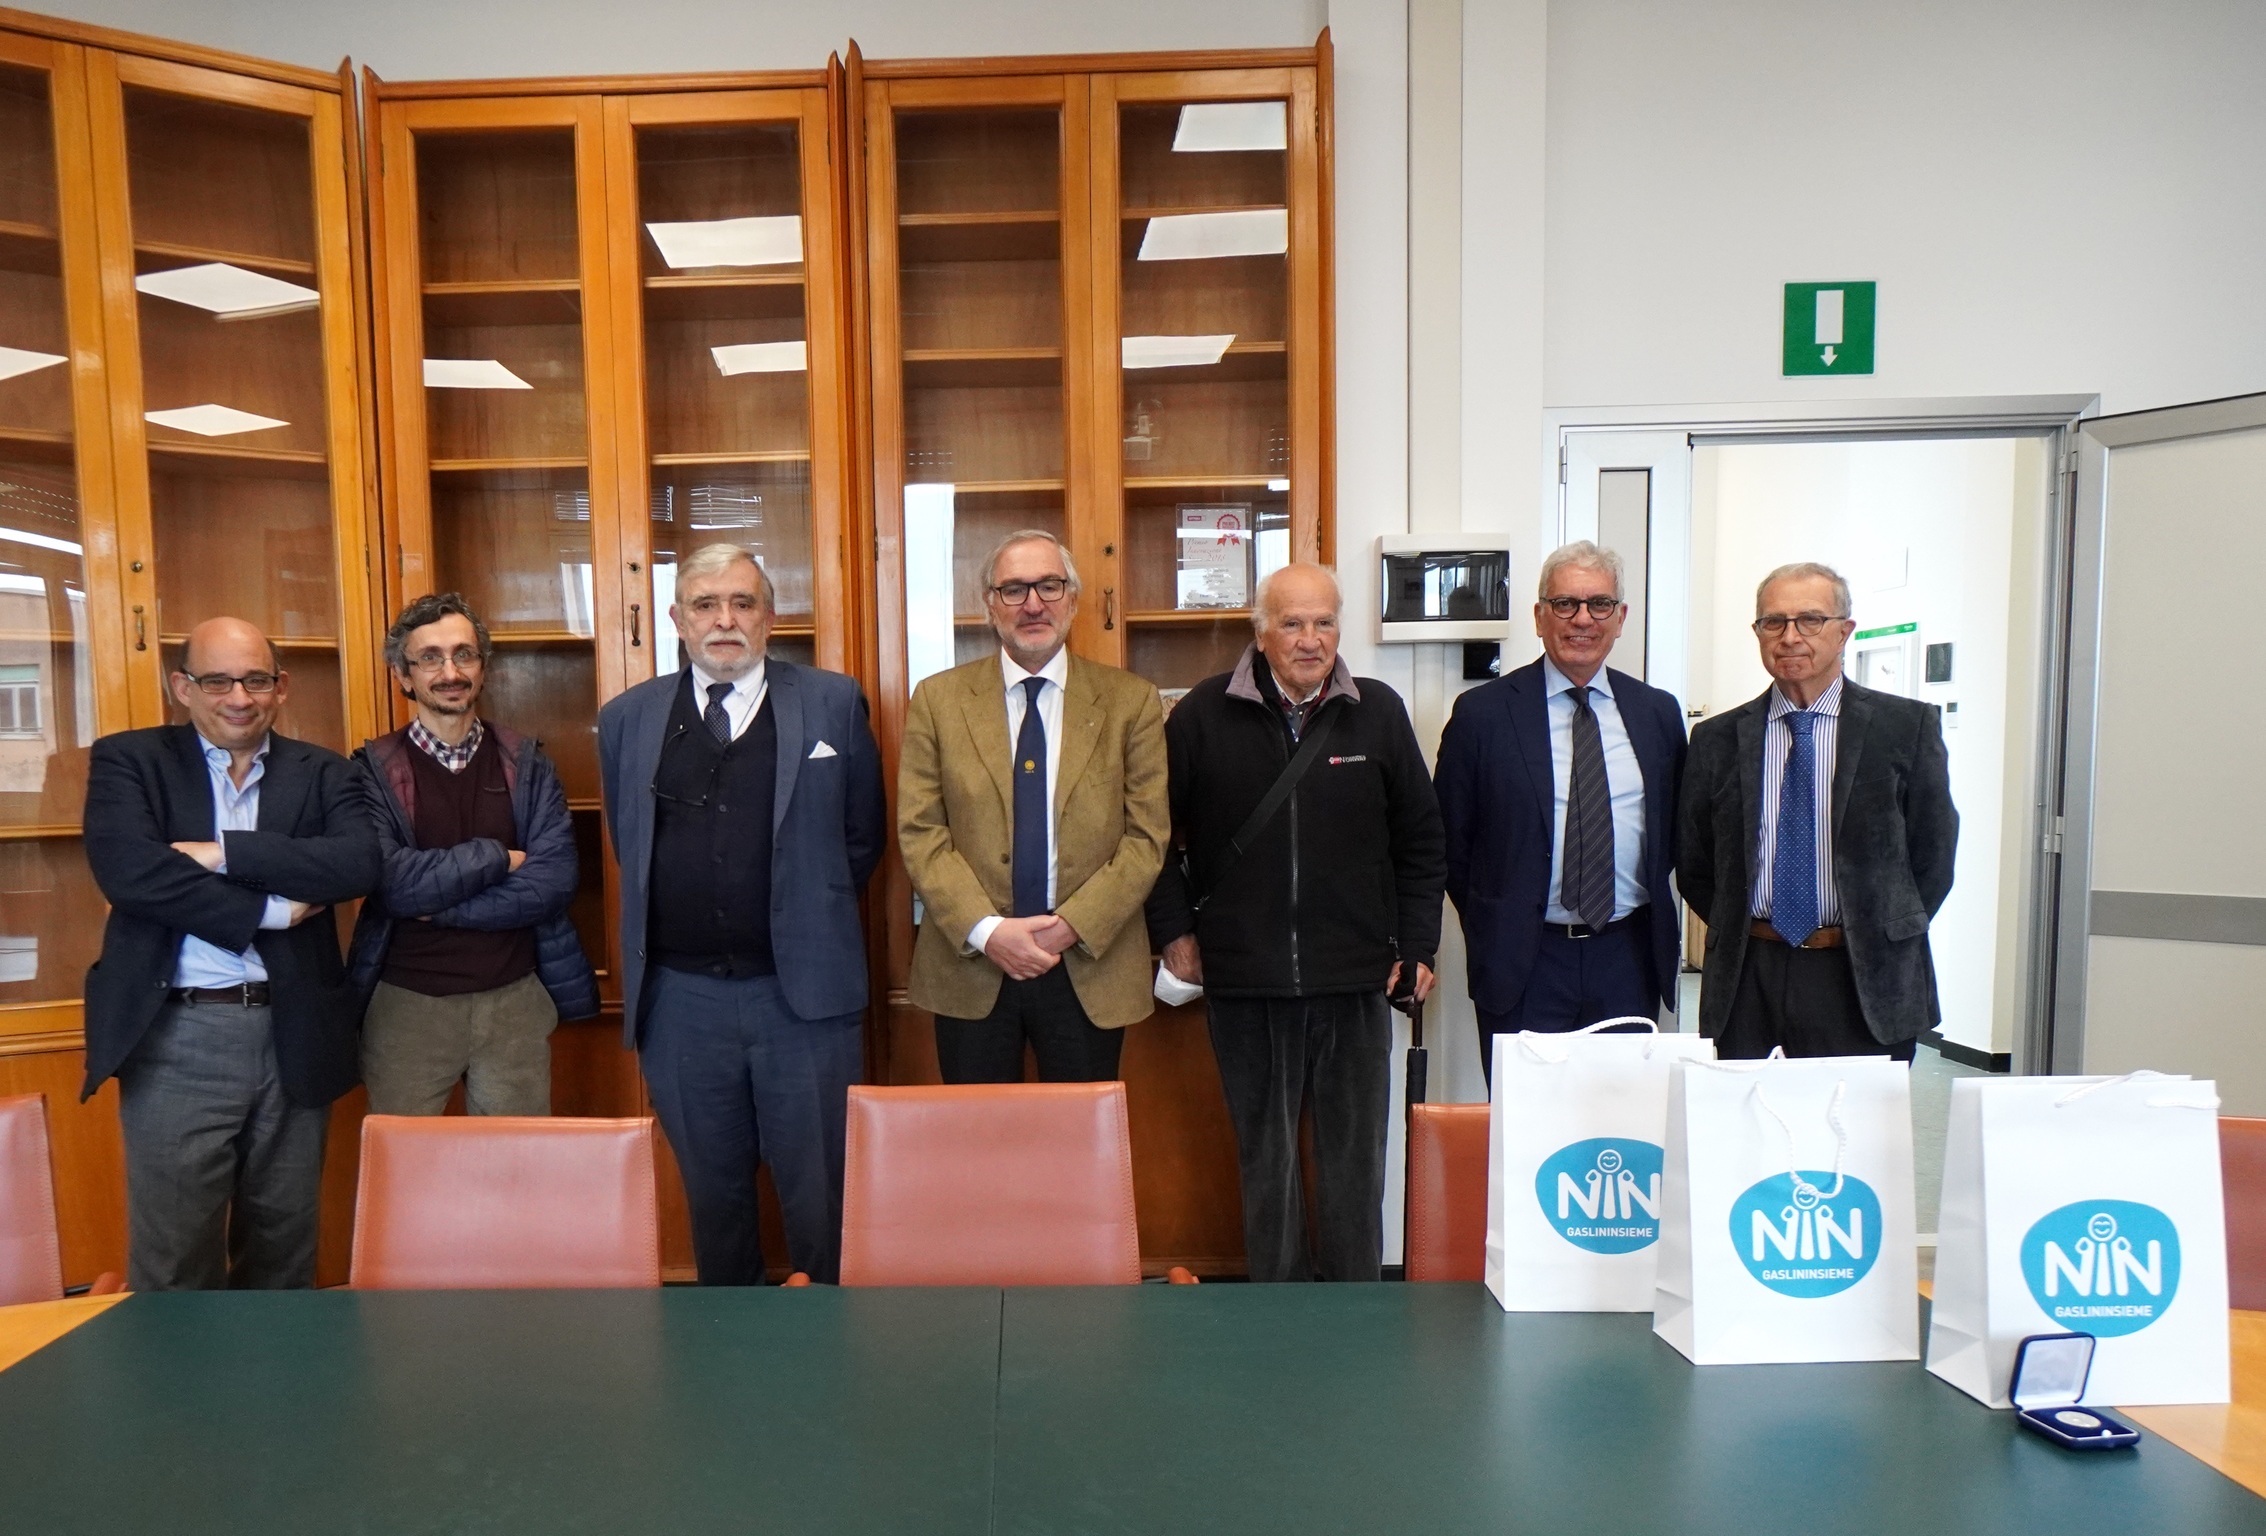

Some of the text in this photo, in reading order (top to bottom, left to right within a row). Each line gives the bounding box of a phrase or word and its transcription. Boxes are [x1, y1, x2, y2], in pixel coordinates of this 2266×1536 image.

[1557, 1169, 1661, 1220] NIN
[1566, 1226, 1653, 1238] GASLININSIEME
[1751, 1205, 1863, 1262] NIN
[1762, 1268, 1855, 1281] GASLININSIEME
[2044, 1236, 2162, 1298] NIN
[2054, 1305, 2154, 1318] GASLININSIEME
